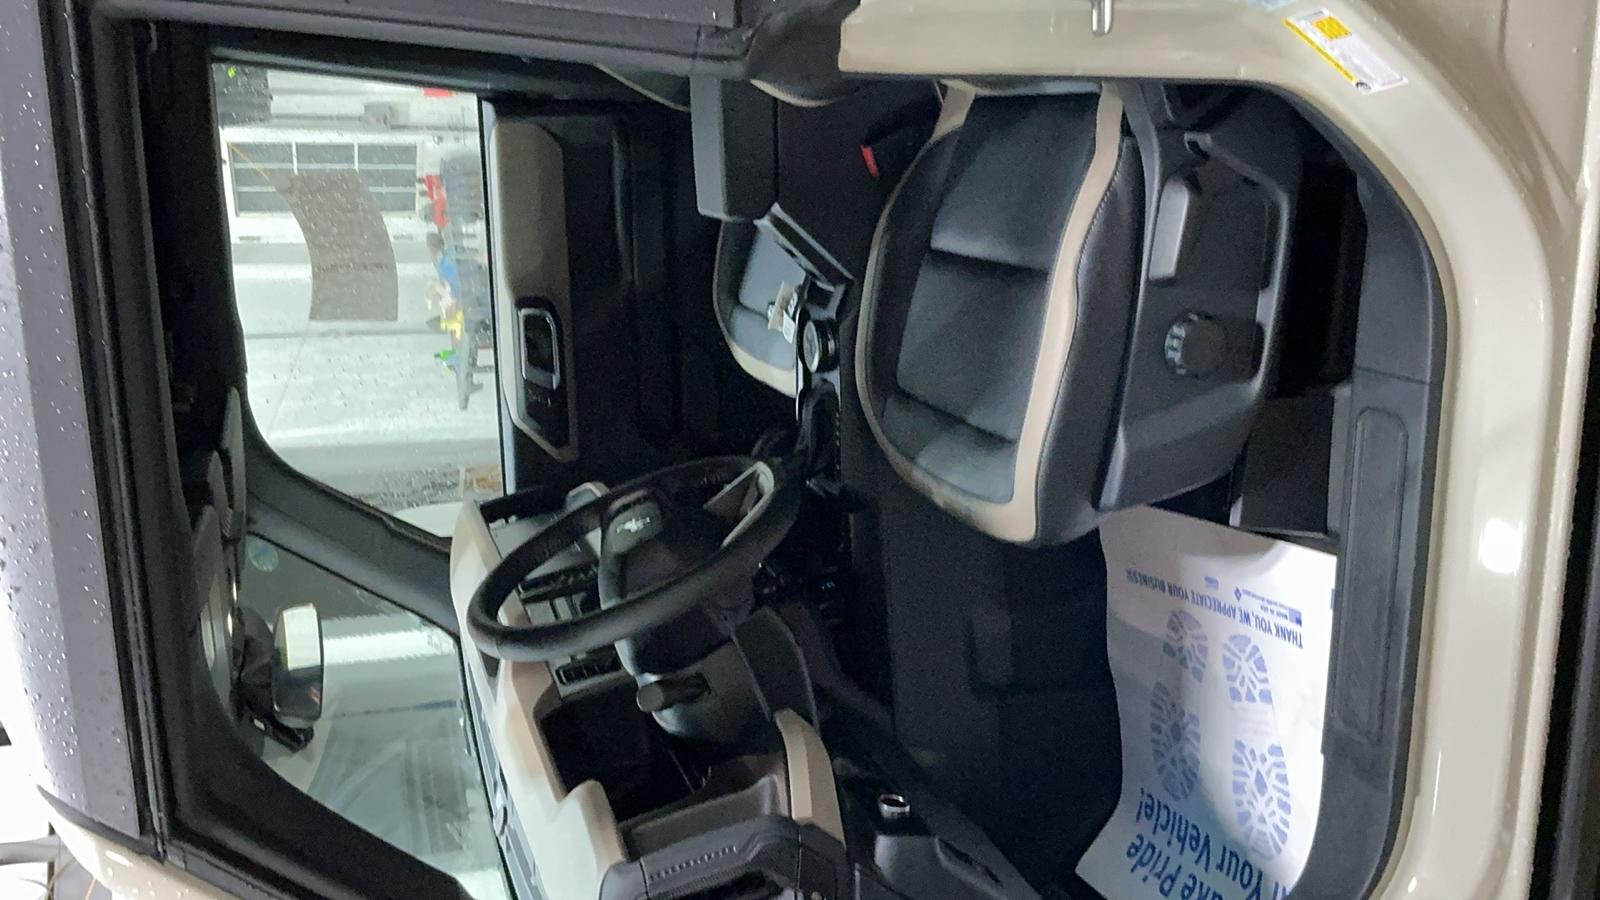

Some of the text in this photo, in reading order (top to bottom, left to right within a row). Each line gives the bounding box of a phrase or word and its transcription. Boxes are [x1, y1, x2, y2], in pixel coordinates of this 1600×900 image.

[1167, 582, 1190, 602] YOUR
[1191, 589, 1237, 620] APPRECIATE
[1238, 607, 1251, 627] WE
[1274, 622, 1303, 649] THANK
[1136, 787, 1263, 900] Your Vehicle!
[1126, 833, 1182, 898] Pride
